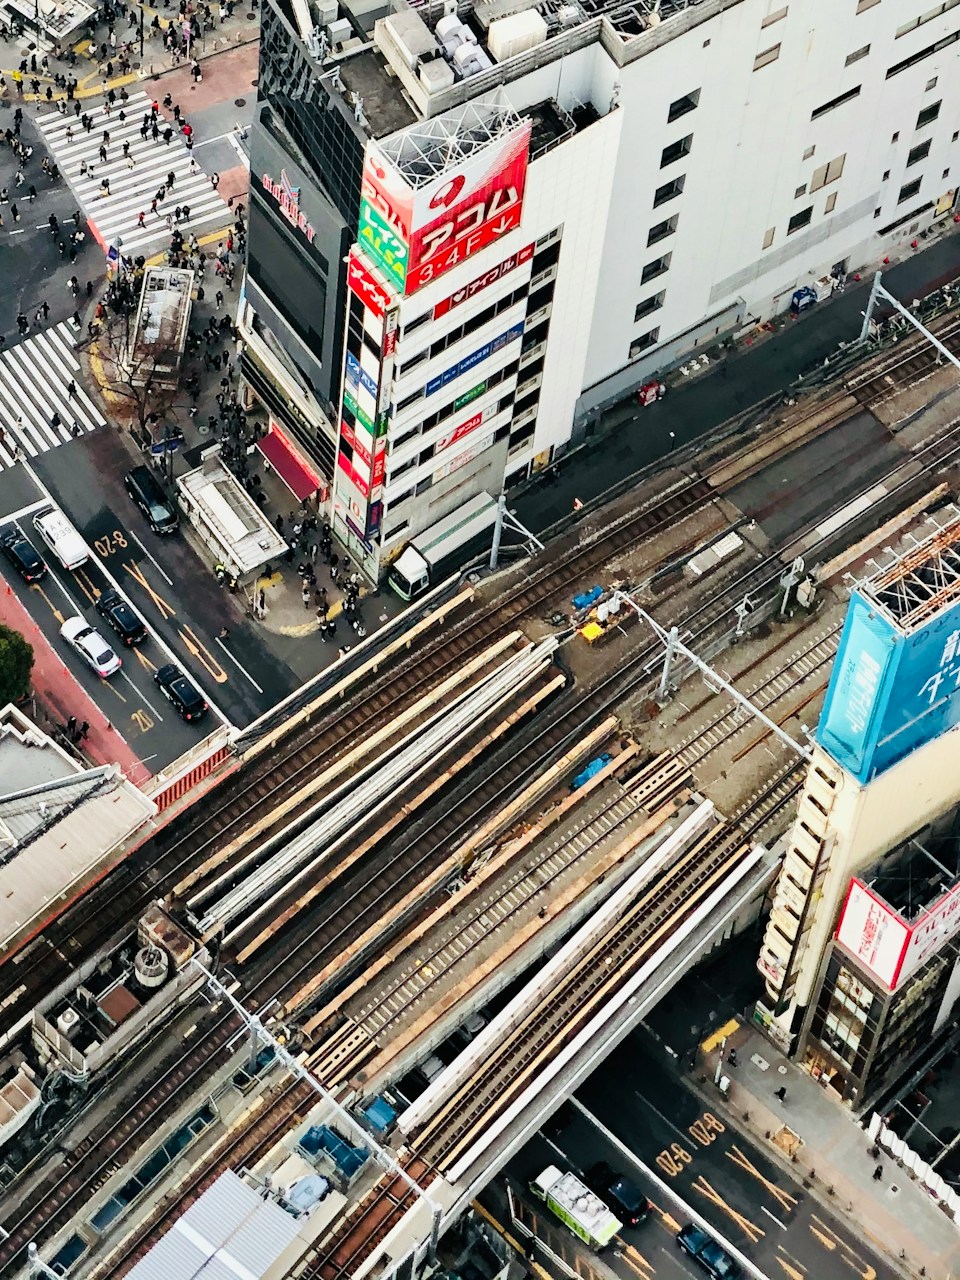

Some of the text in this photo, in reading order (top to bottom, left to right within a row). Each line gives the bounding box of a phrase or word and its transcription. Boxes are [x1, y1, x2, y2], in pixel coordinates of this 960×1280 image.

[364, 204, 407, 258] レイク
[420, 186, 519, 264] アコム
[361, 226, 405, 280] ALSA
[469, 259, 515, 294] アイフル
[456, 419, 480, 437] アコム
[95, 530, 128, 557] 8-20
[689, 1112, 725, 1146] 8-20
[656, 1142, 692, 1177] 8-20
